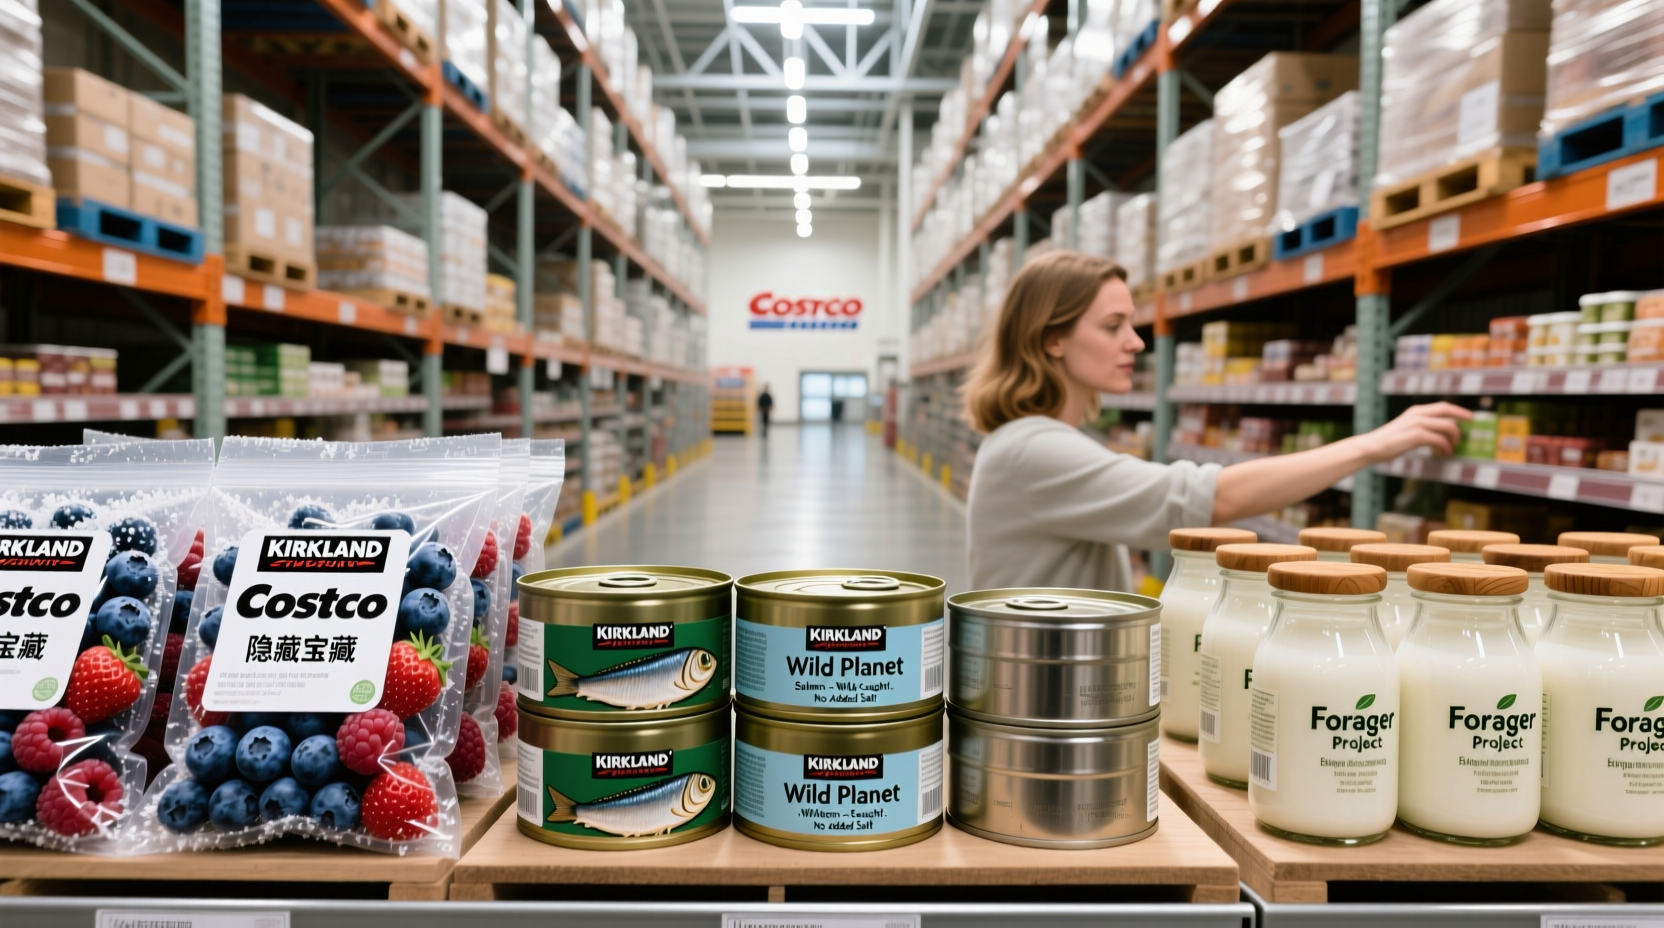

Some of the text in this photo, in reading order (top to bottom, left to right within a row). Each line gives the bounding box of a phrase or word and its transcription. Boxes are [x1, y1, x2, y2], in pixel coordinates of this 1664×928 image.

[267, 539, 383, 558] KIRKLAND
[236, 583, 388, 619] Costco
[245, 634, 358, 663] 隐藏宝藏
[786, 656, 904, 677] Wild Planet
[1311, 706, 1394, 737] Forager
[1449, 705, 1536, 737] Forager
[1332, 735, 1383, 753] Project
[1472, 735, 1524, 752] Project
[784, 782, 901, 805] Wild Planet
